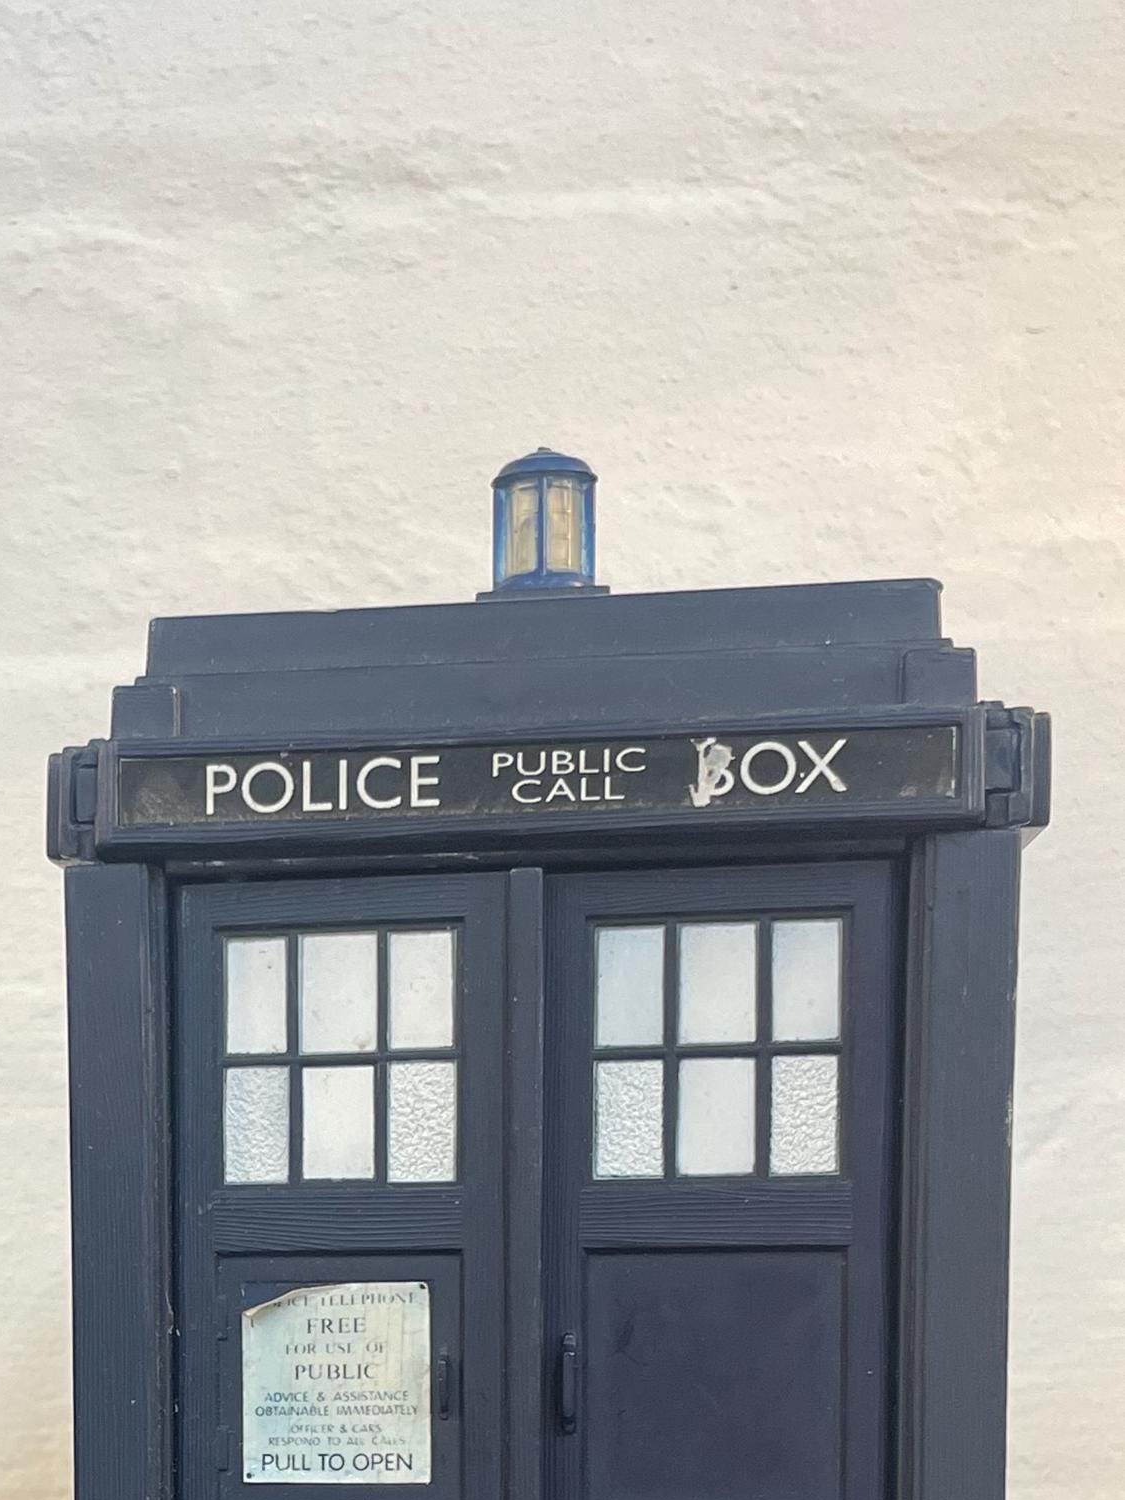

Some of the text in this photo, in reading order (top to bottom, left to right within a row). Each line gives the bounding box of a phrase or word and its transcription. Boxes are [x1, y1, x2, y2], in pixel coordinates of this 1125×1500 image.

[205, 755, 440, 815] POLICE
[491, 747, 647, 777] PUBLIC
[511, 776, 625, 805] CALL
[321, 1292, 415, 1306] TELEPHONE
[307, 1317, 367, 1334] FREE
[286, 1342, 386, 1355] FOR USE OF
[295, 1363, 376, 1380] PUBLIC
[265, 1390, 409, 1402] ADVICE & ASSISTANCE
[255, 1404, 418, 1416] OBTAINABLE IMMEDIATELY
[291, 1424, 382, 1434] OFFICER & CARS
[269, 1437, 320, 1446] RESPOND
[327, 1437, 340, 1445] TO
[372, 1436, 405, 1445] CALLS
[261, 1453, 413, 1471] PULL TO OPEN
